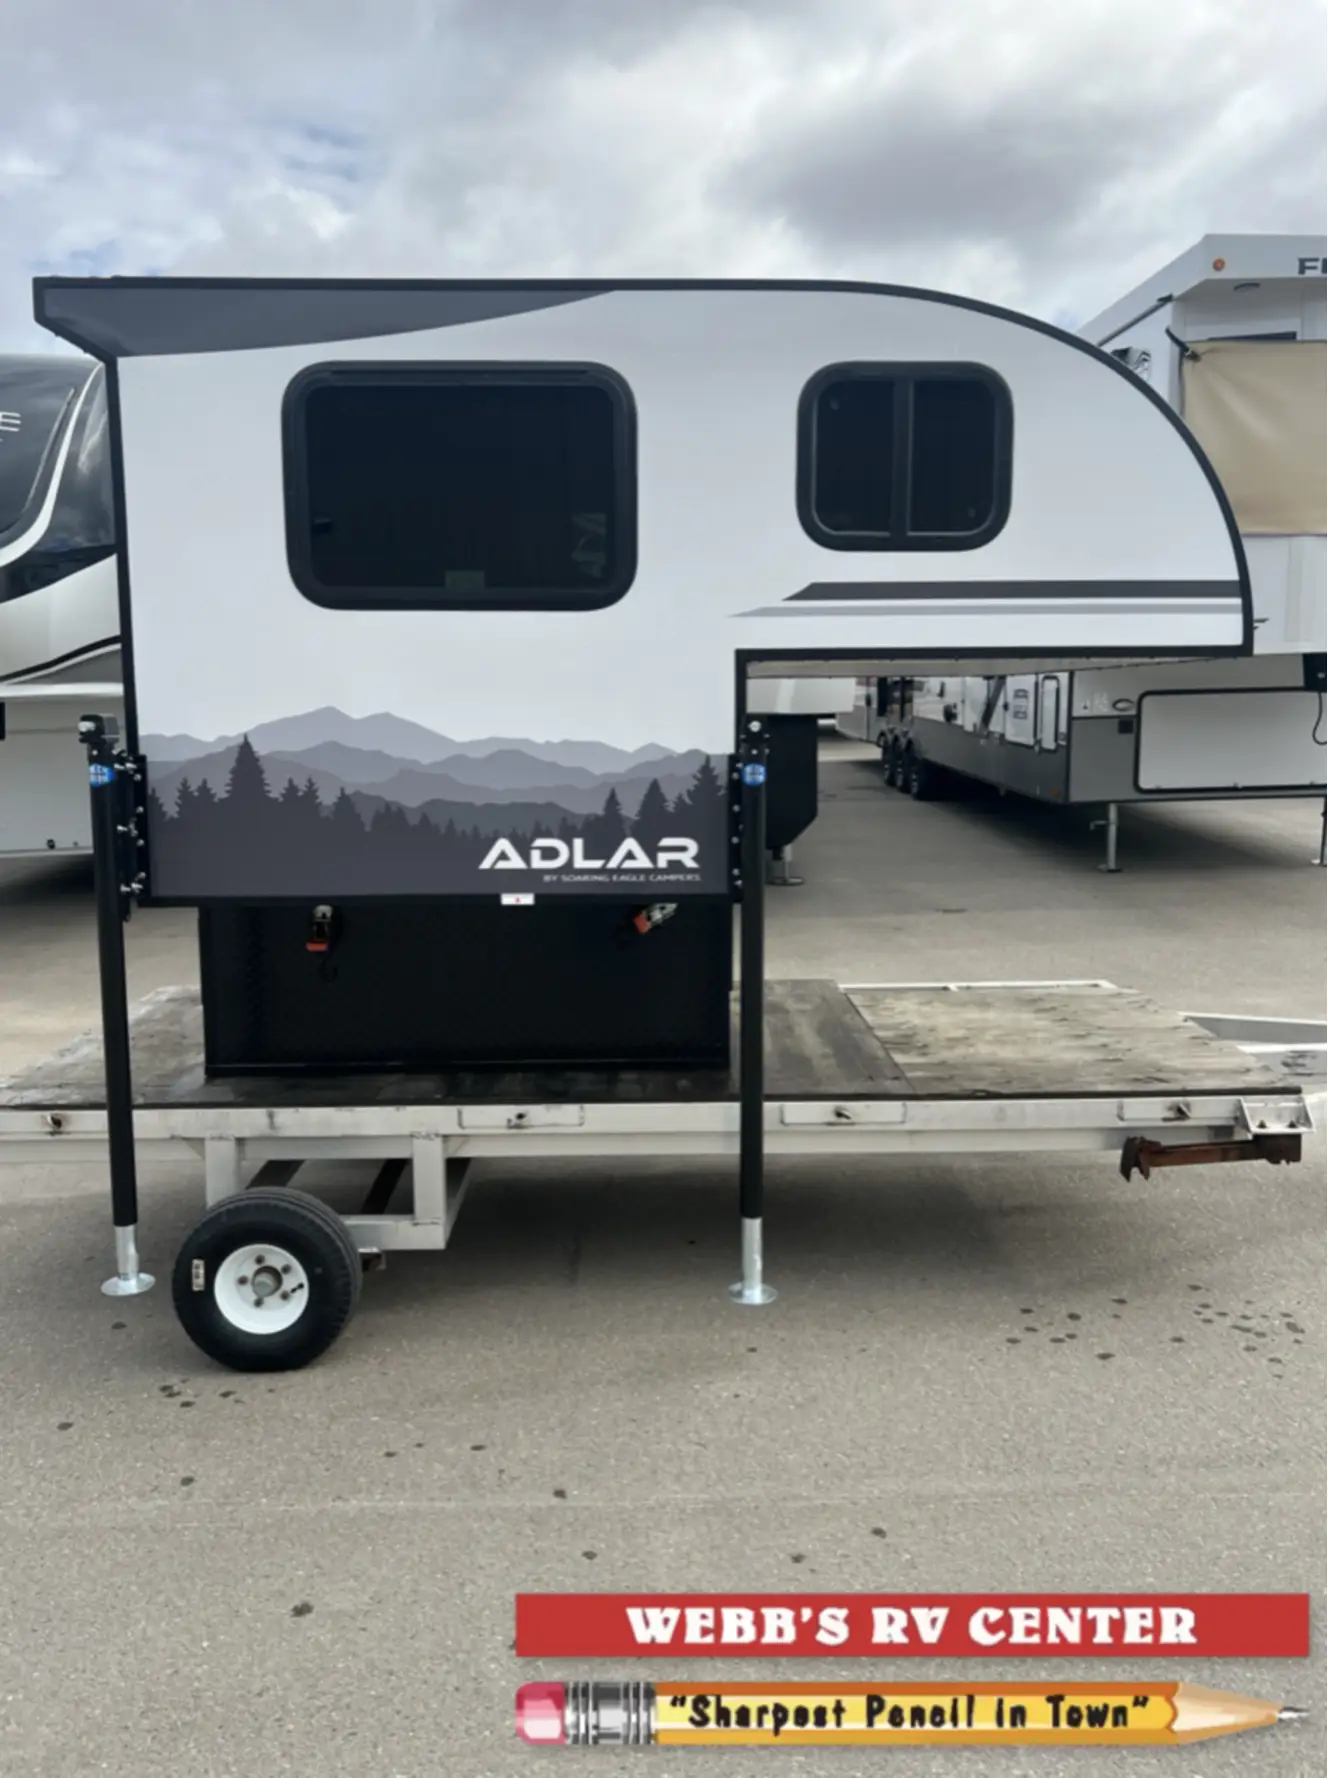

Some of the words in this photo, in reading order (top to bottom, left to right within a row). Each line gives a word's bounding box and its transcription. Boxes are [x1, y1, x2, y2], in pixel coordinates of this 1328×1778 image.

[1298, 258, 1327, 275] F
[478, 837, 700, 869] ADLAR
[543, 874, 558, 882] BY
[561, 874, 610, 882] SOARING
[612, 874, 646, 882] EAGLE
[649, 874, 701, 882] CAMPERS
